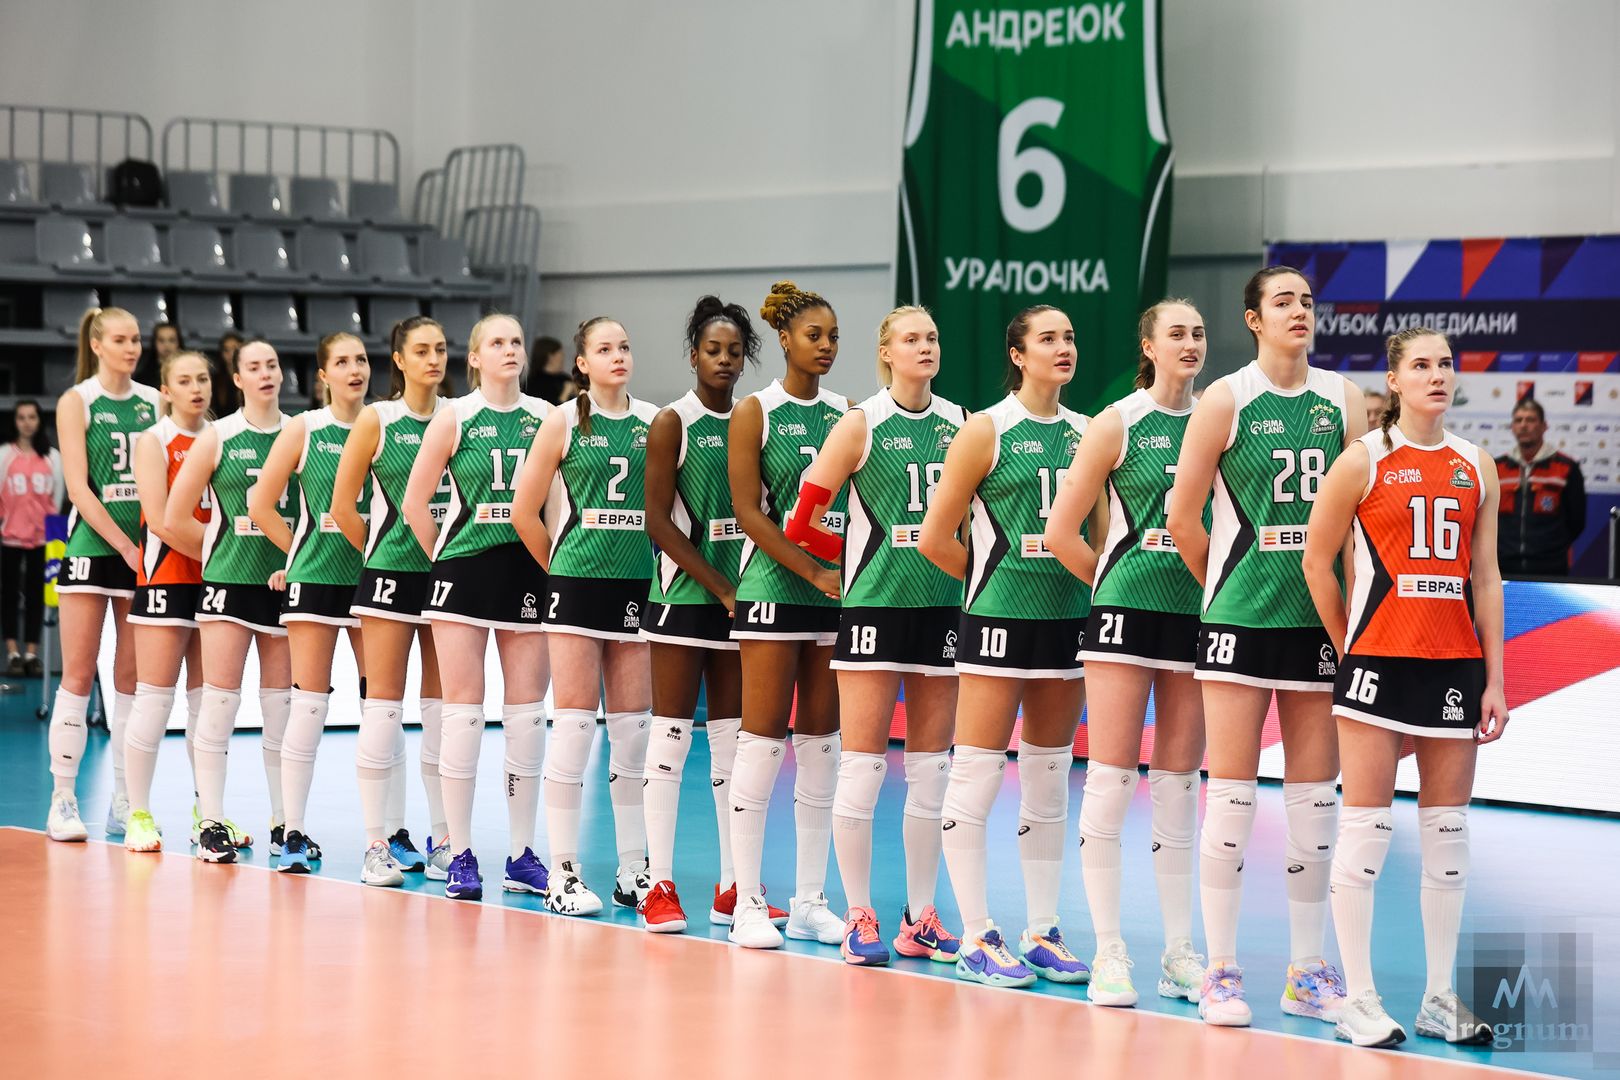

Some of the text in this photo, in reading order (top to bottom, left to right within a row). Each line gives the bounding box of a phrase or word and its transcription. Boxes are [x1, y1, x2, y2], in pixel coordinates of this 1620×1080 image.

[945, 2, 1126, 54] АНДРЕЮК
[998, 96, 1066, 233] 6
[945, 257, 1109, 294] УРАЛОЧКА
[1315, 312, 1378, 336] КУБОК
[1263, 426, 1285, 434] LAND
[489, 448, 527, 491] 17
[607, 456, 630, 502] 2
[1271, 448, 1327, 504] 28
[1398, 475, 1422, 483] LAND
[598, 514, 643, 526] ЕВРАЗ
[1408, 496, 1461, 561] 16
[68, 557, 91, 580] 30
[202, 587, 227, 613] 24
[288, 583, 301, 607] 9
[372, 578, 397, 604] 12
[430, 580, 453, 607] 17
[1417, 580, 1462, 595] ЕВРАЗ
[147, 589, 167, 614] 15
[548, 592, 560, 619] 2
[747, 602, 777, 625] 20
[657, 604, 672, 627] 7
[850, 625, 877, 655] 18
[1098, 613, 1124, 645] 21
[942, 651, 955, 659] LAN
[979, 627, 1008, 659] 10
[1206, 632, 1236, 665] 28
[1345, 667, 1380, 705] 16
[1442, 713, 1465, 721] LAND
